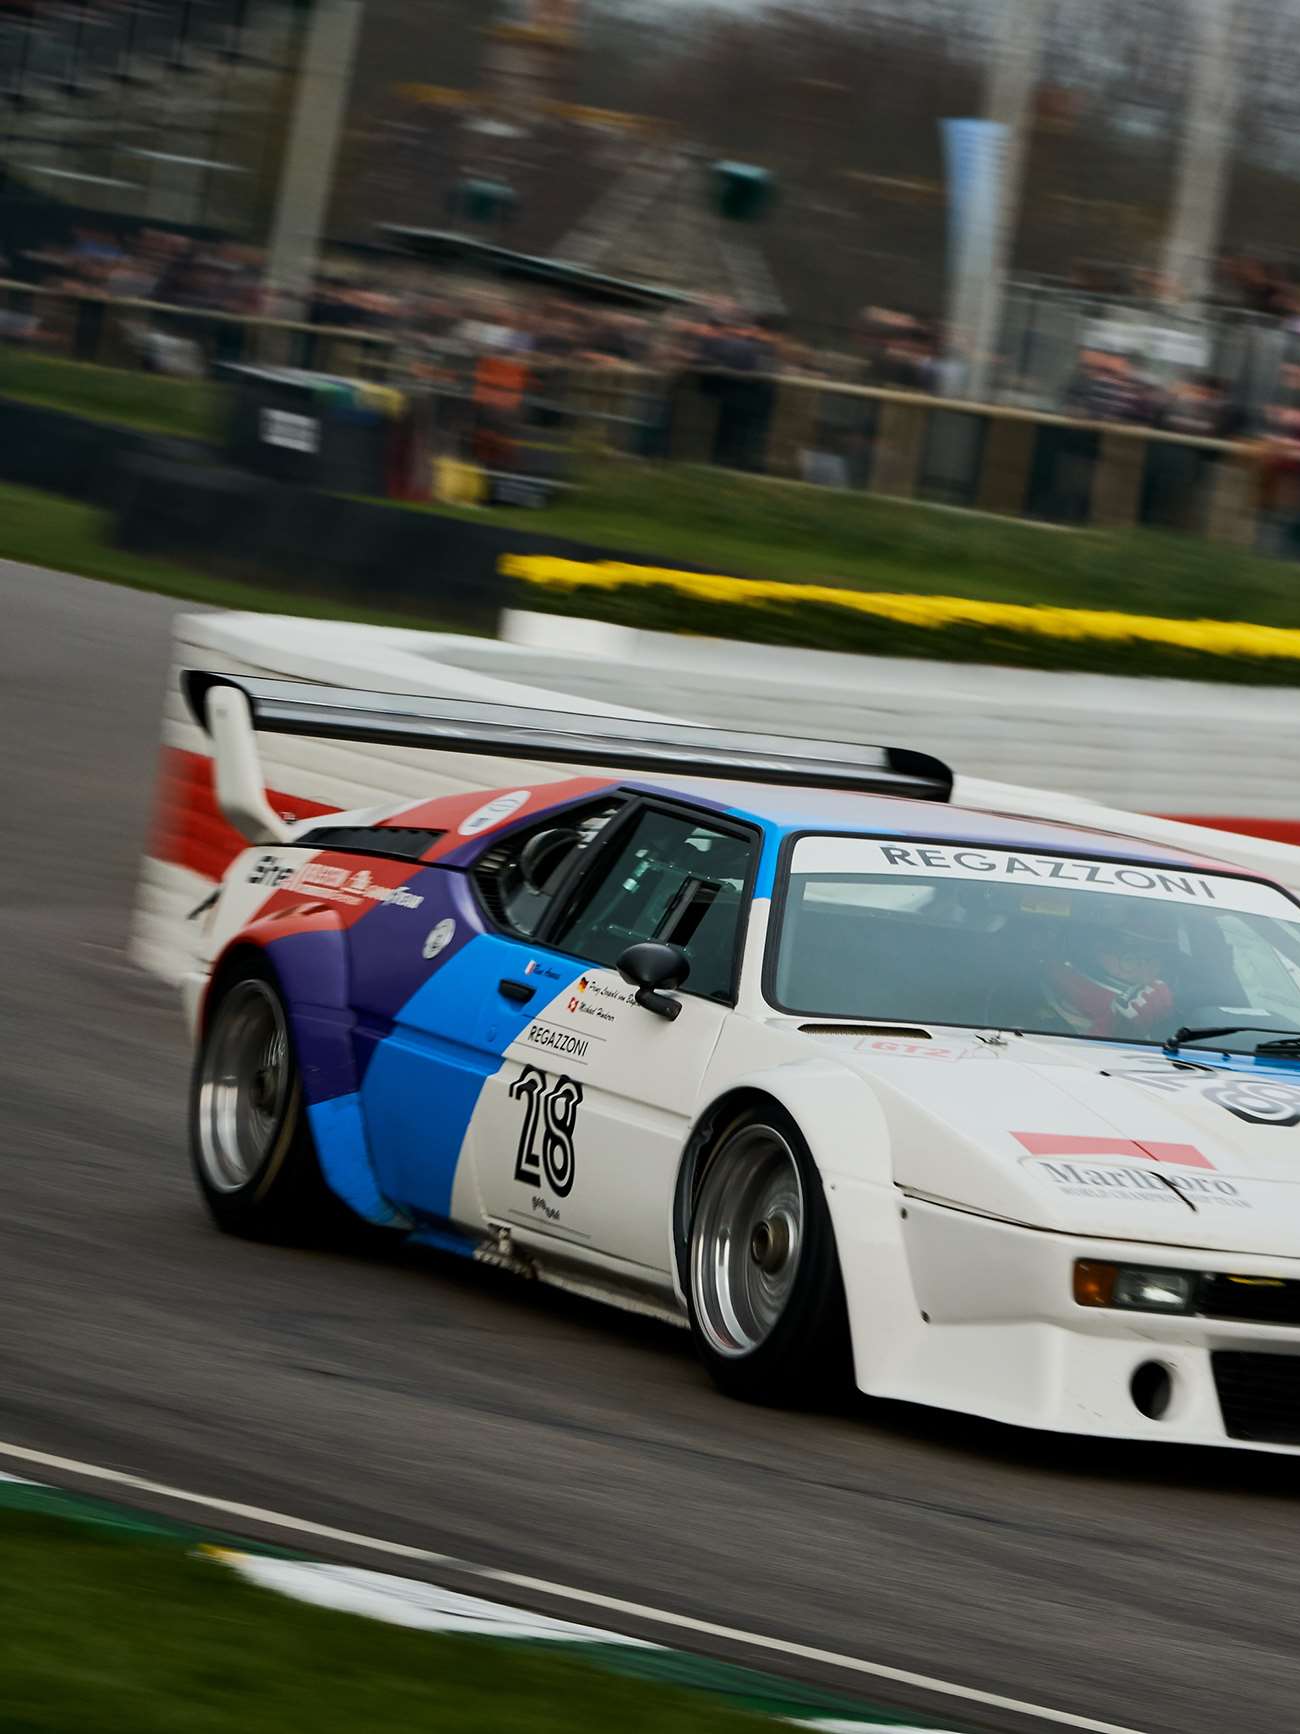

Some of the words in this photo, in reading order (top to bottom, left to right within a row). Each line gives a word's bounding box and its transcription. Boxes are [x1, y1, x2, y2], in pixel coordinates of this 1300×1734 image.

[879, 845, 1216, 900] REGAZZONI
[528, 1024, 589, 1057] REGAZZONI
[509, 1063, 584, 1198] 28
[1040, 1161, 1240, 1197] Marlboro
